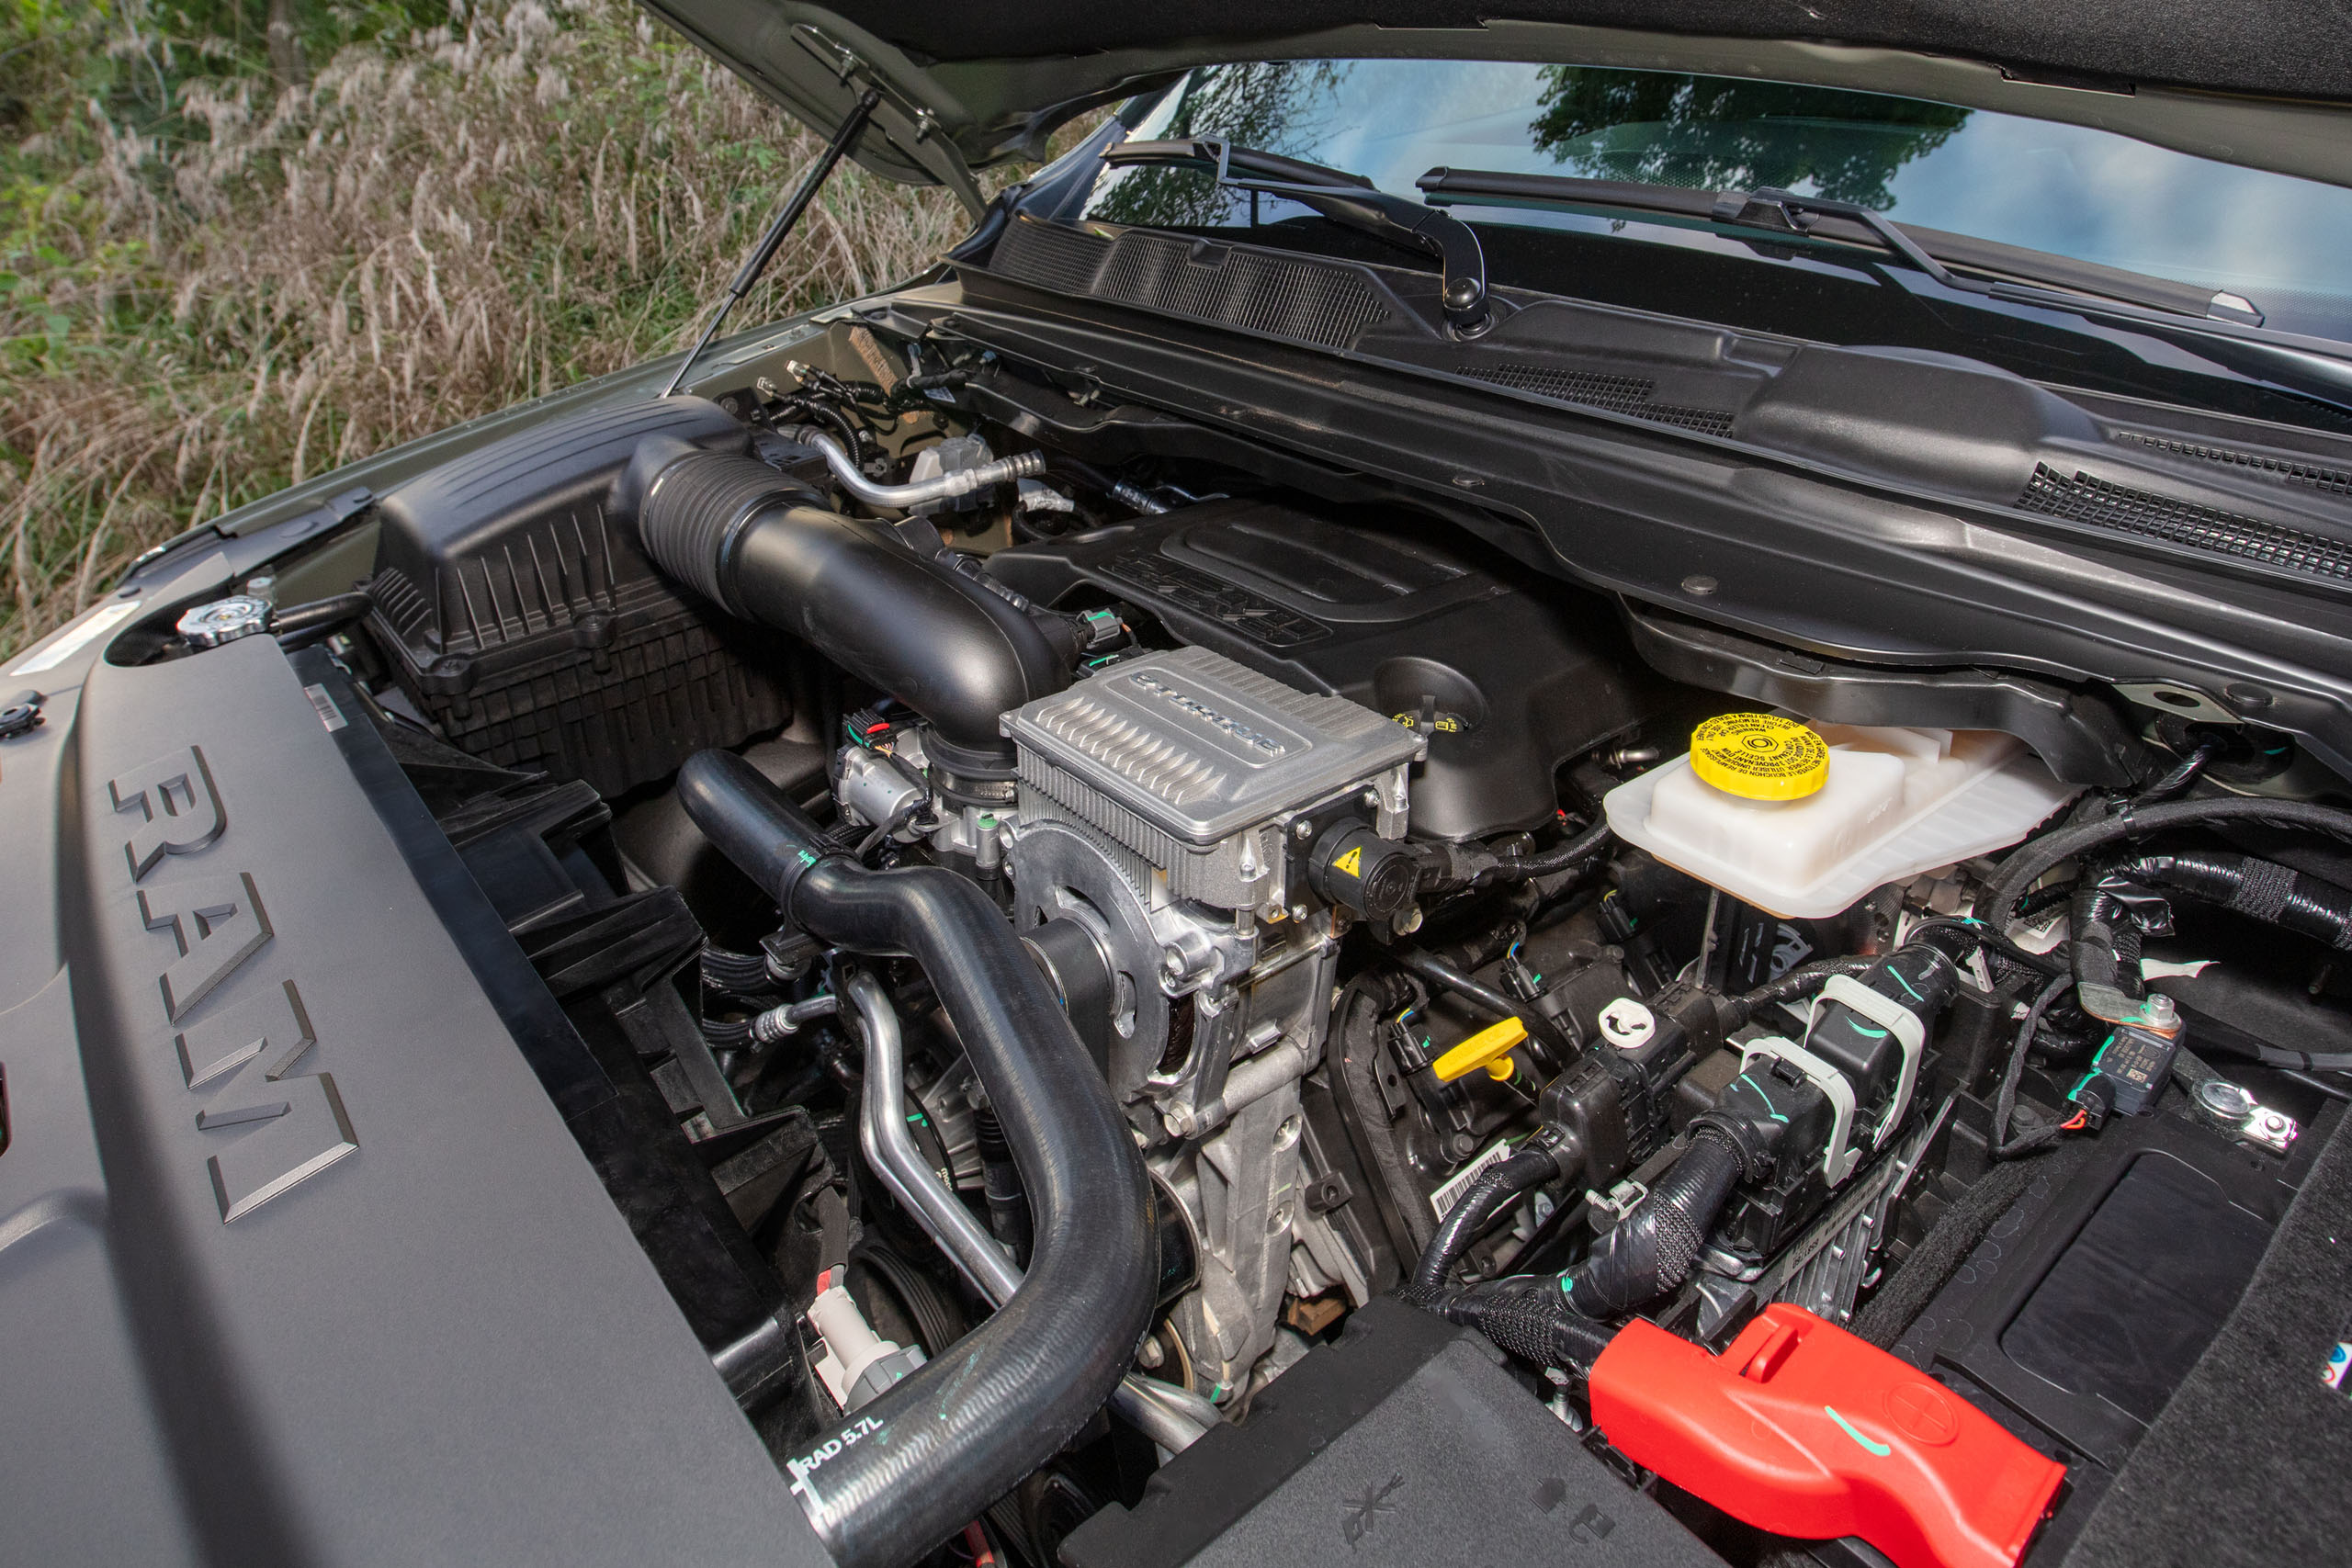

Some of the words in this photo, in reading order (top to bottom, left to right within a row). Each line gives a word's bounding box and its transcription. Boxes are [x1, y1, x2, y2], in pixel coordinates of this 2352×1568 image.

[1785, 720, 1801, 728] DOT
[1711, 749, 1750, 771] UNIQUEMENT
[1734, 755, 1780, 767] PROVENANT
[1769, 739, 1794, 761] CONTENANT
[107, 744, 360, 1225] RAM
[801, 1439, 842, 1475] RAD
[841, 1416, 885, 1447] 5.7L
